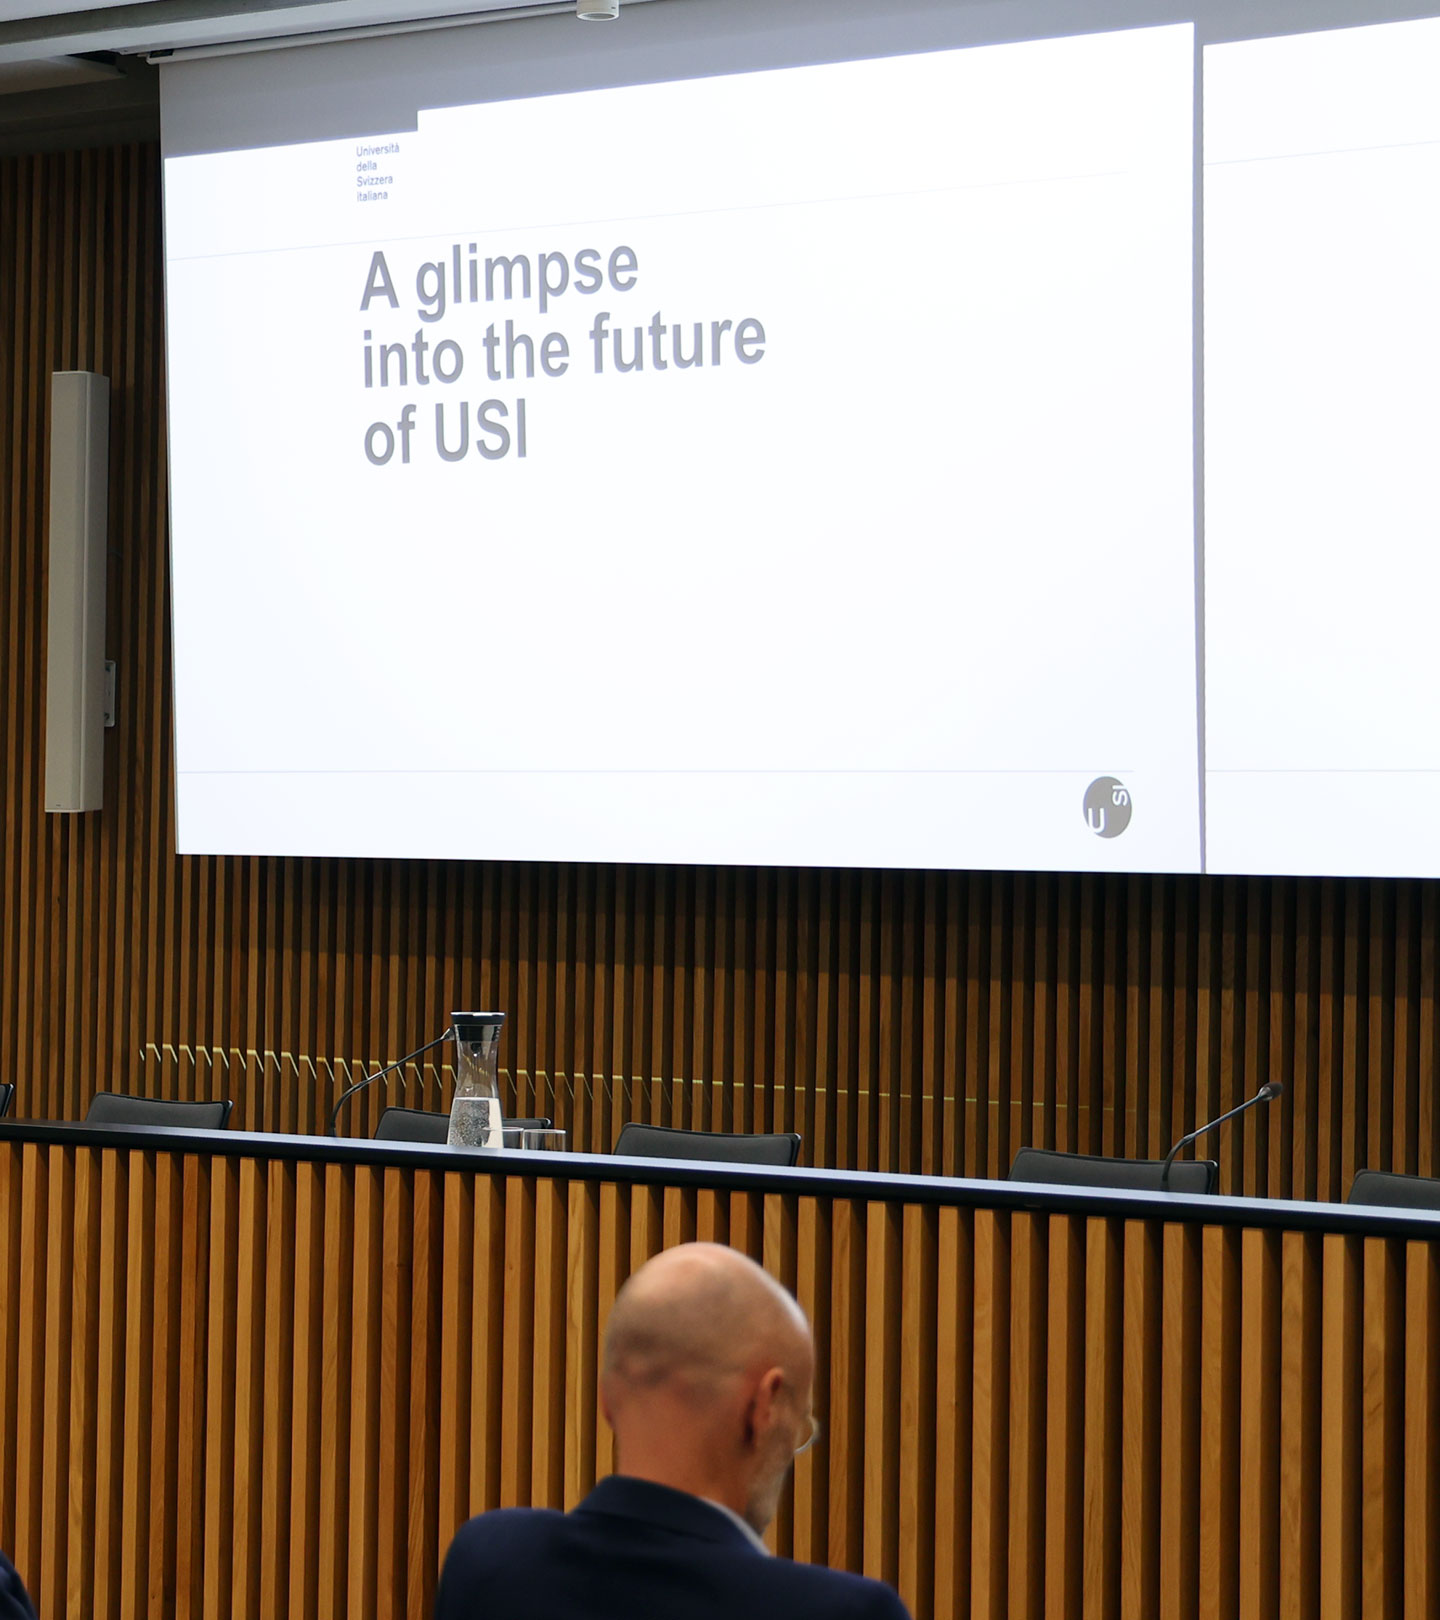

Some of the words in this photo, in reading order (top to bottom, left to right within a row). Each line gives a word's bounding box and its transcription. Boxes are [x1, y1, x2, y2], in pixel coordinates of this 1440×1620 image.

[356, 142, 400, 157] Università
[356, 160, 378, 172] della
[356, 175, 394, 187] Svizzera
[360, 251, 400, 311] A
[416, 243, 639, 322] glimpse
[363, 328, 464, 389] into
[483, 319, 570, 380] the
[590, 311, 766, 373] future
[364, 404, 417, 465] of
[436, 398, 527, 463] USI
